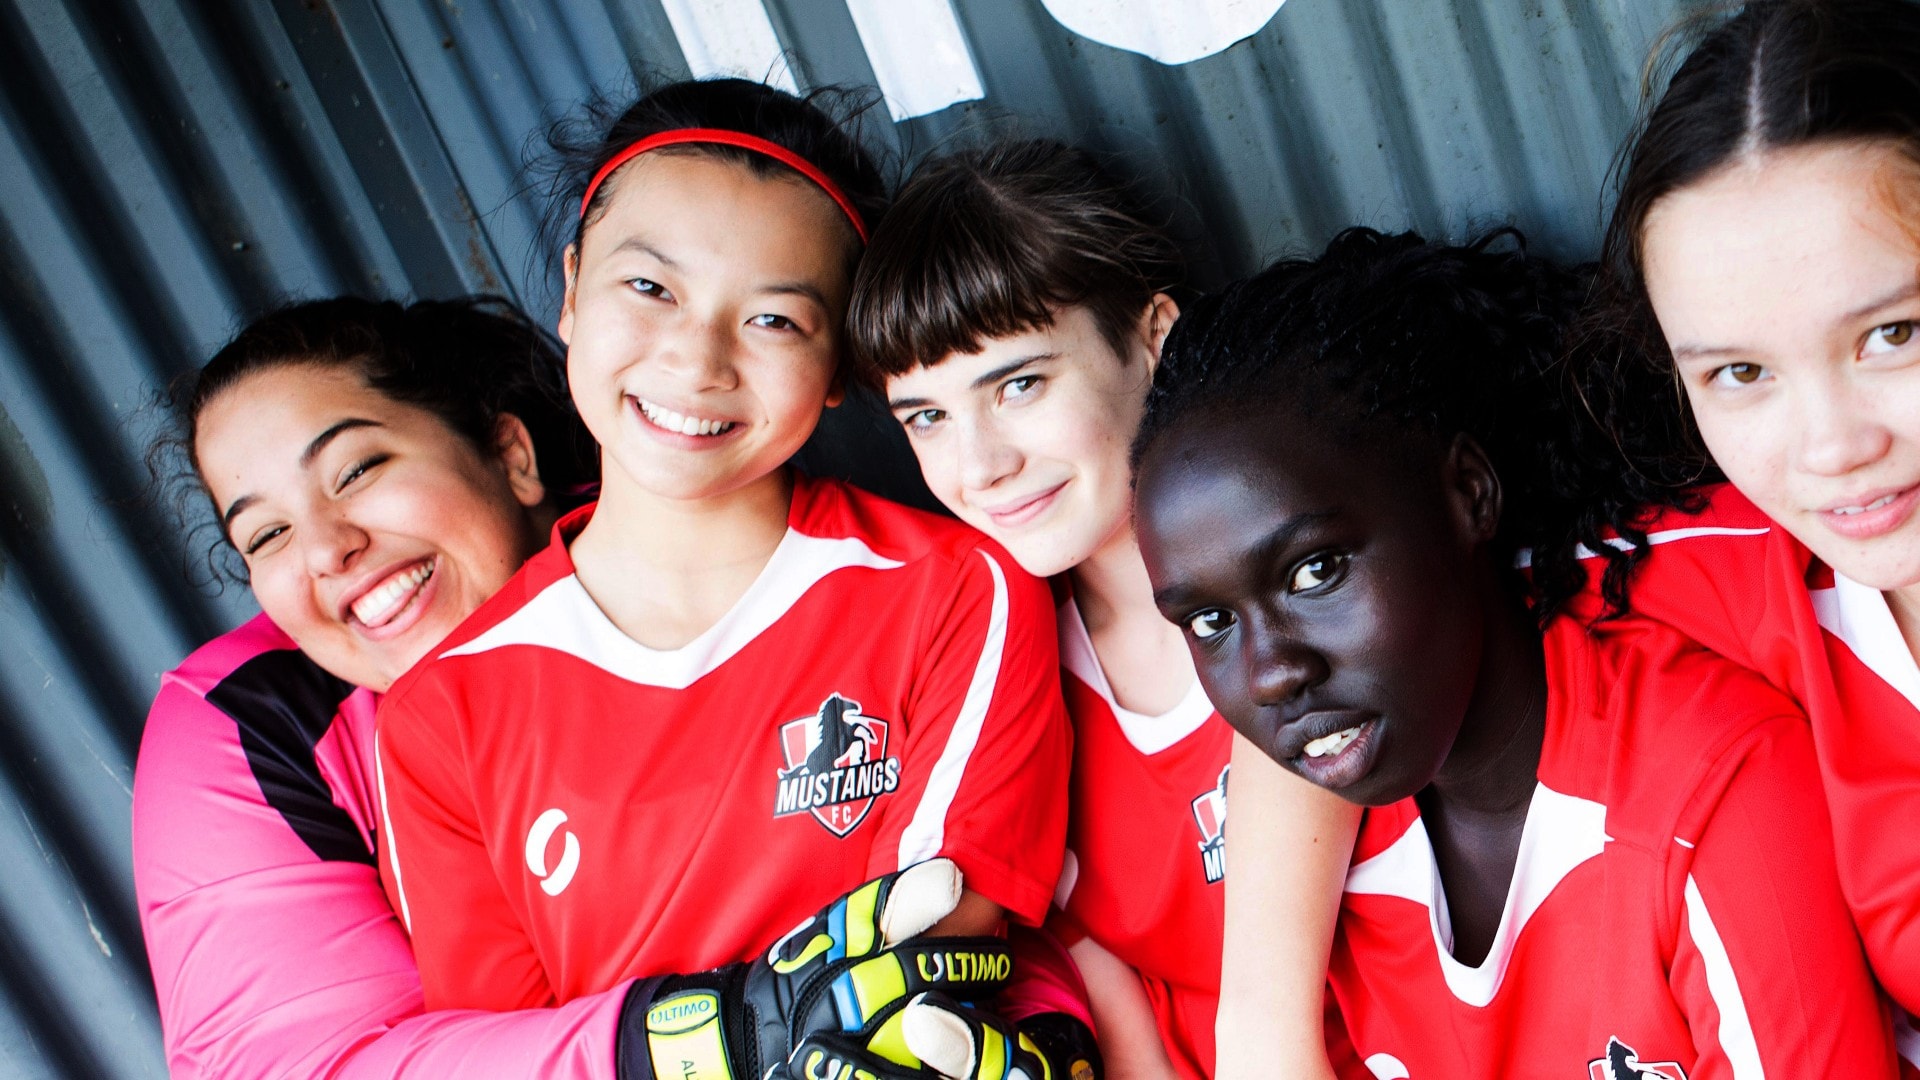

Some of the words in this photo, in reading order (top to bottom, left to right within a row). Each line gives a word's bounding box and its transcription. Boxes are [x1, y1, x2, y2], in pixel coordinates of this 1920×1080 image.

[776, 757, 899, 814] MUSTANGS
[917, 952, 1011, 982] ULTIMO
[651, 1000, 710, 1023] ULTIMO
